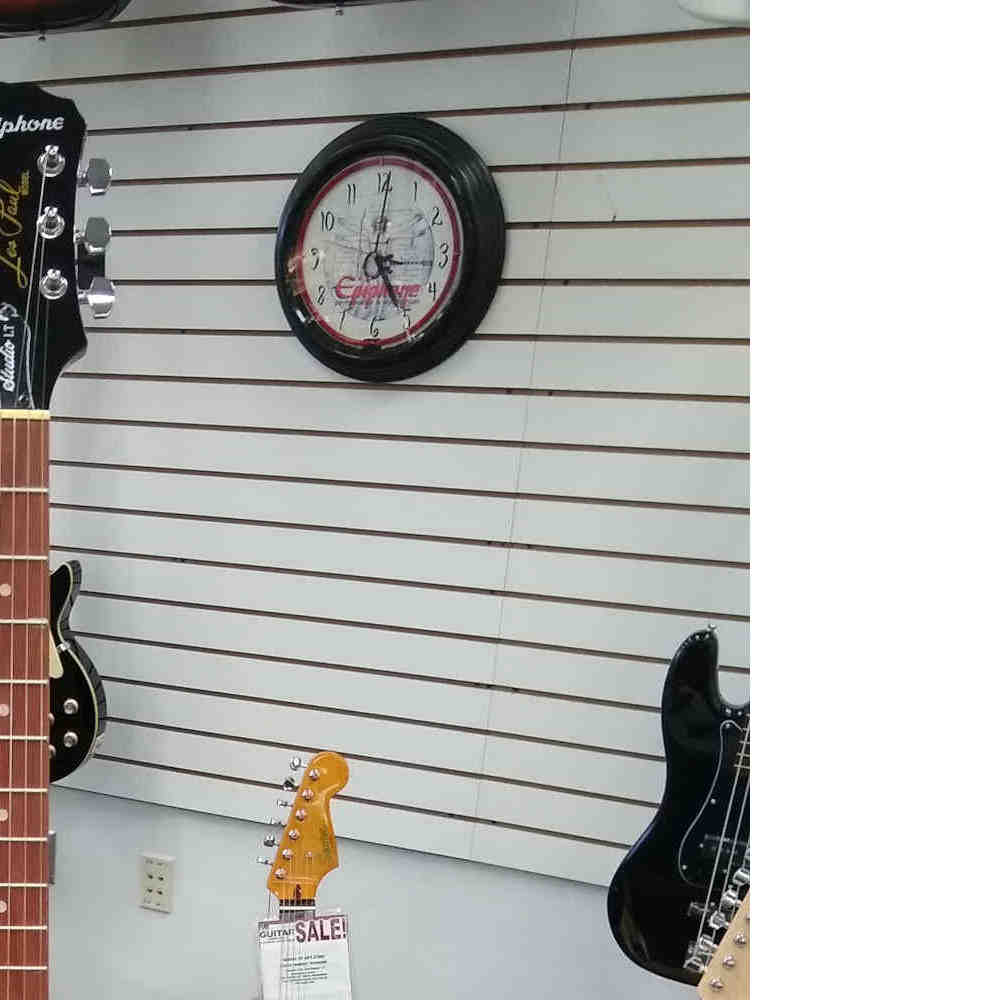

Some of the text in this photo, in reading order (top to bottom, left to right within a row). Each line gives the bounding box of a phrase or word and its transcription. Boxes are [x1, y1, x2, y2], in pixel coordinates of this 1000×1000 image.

[377, 171, 393, 192] 12
[414, 181, 418, 201] 1
[347, 183, 357, 205] 11
[320, 211, 336, 232] 10
[431, 207, 443, 226] 2
[438, 243, 449, 269] 3
[428, 282, 437, 301] 4
[370, 315, 385, 337] 6
[0, 324, 15, 392] Studio LT
[294, 919, 347, 943] SALE!
